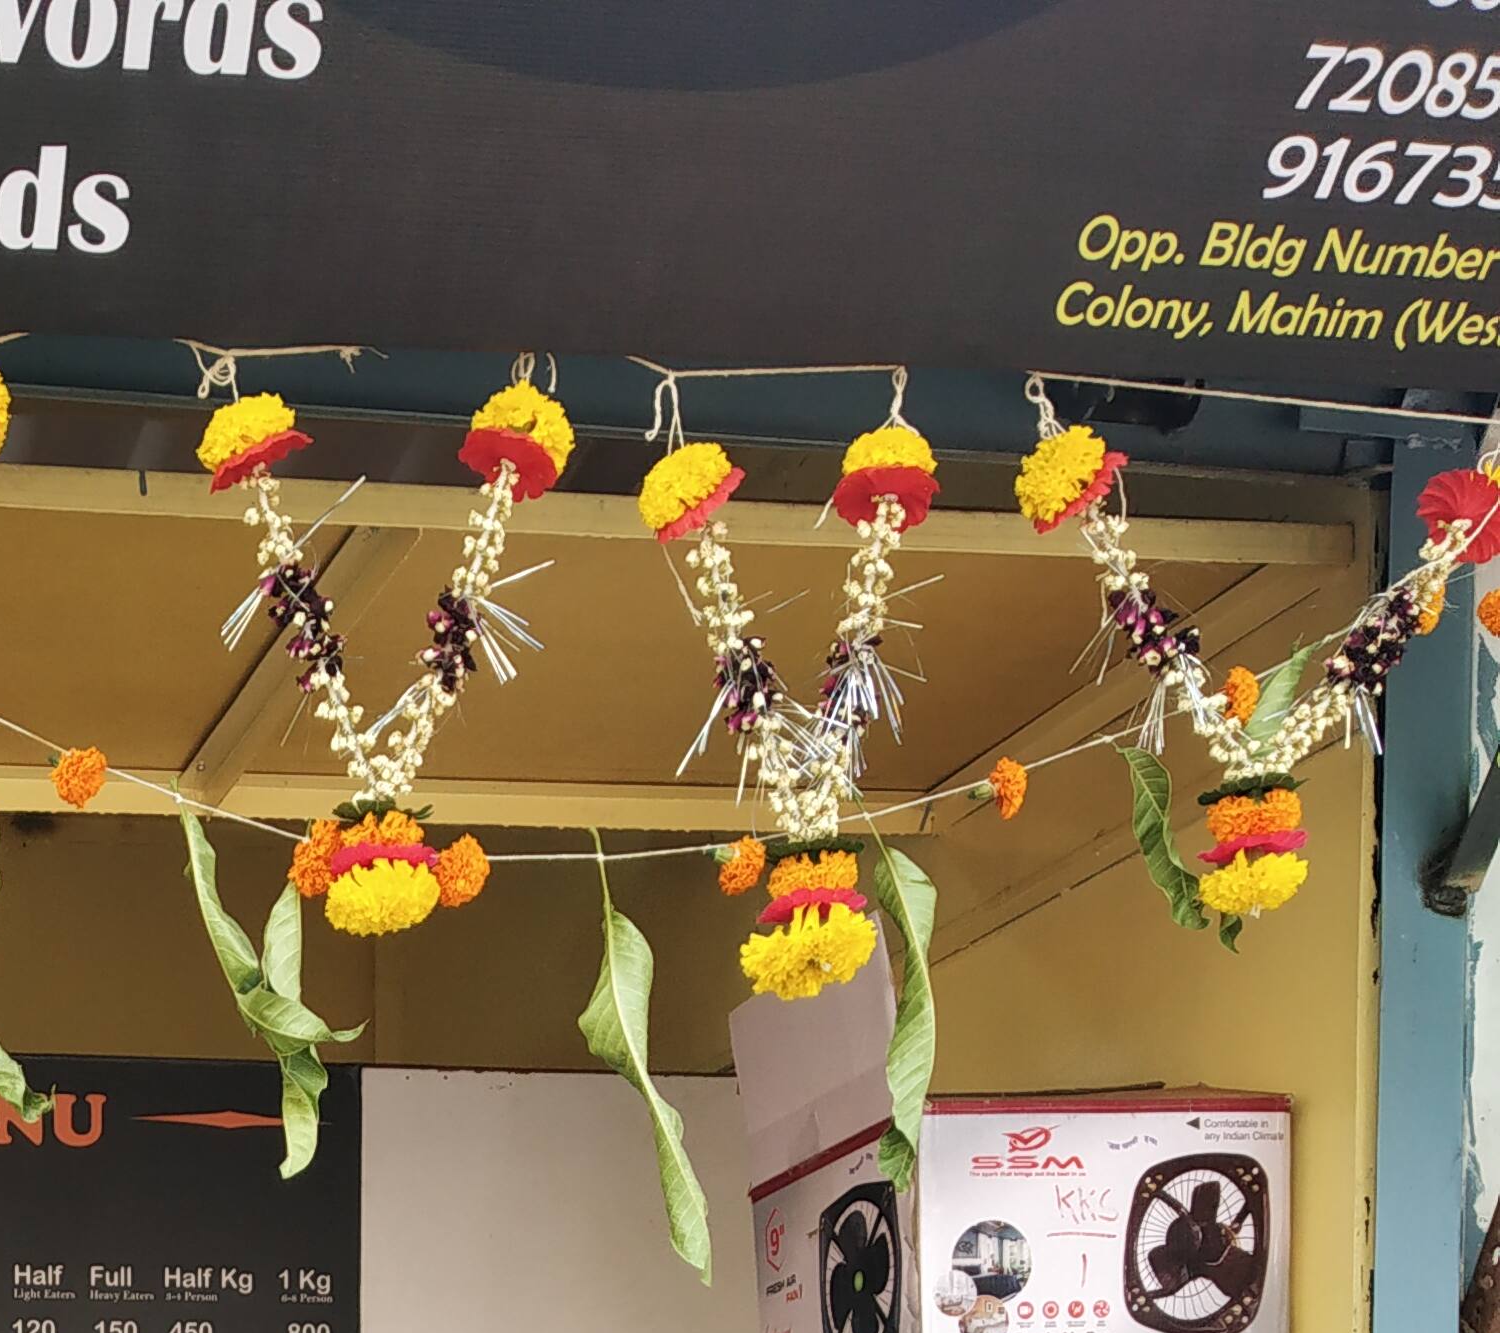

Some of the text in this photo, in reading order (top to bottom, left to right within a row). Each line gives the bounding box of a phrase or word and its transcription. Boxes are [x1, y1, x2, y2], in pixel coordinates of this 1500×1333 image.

[1295, 43, 1500, 119] 72085
[1078, 214, 1500, 281] Opp. Bldg Number
[1056, 281, 1500, 351] Colony, Mahim (Wes
[1203, 1118, 1269, 1129] Comfortable in
[1203, 1131, 1221, 1143] any
[1222, 1130, 1250, 1141] Indian
[971, 1154, 1085, 1170] SSM
[14, 1264, 64, 1286] Half
[90, 1265, 132, 1287] Full
[164, 1267, 253, 1295] Half Kg
[278, 1269, 331, 1297] 1 Kg
[13, 1287, 76, 1302] Light Eaters
[89, 1289, 155, 1303] Heavy Eaters
